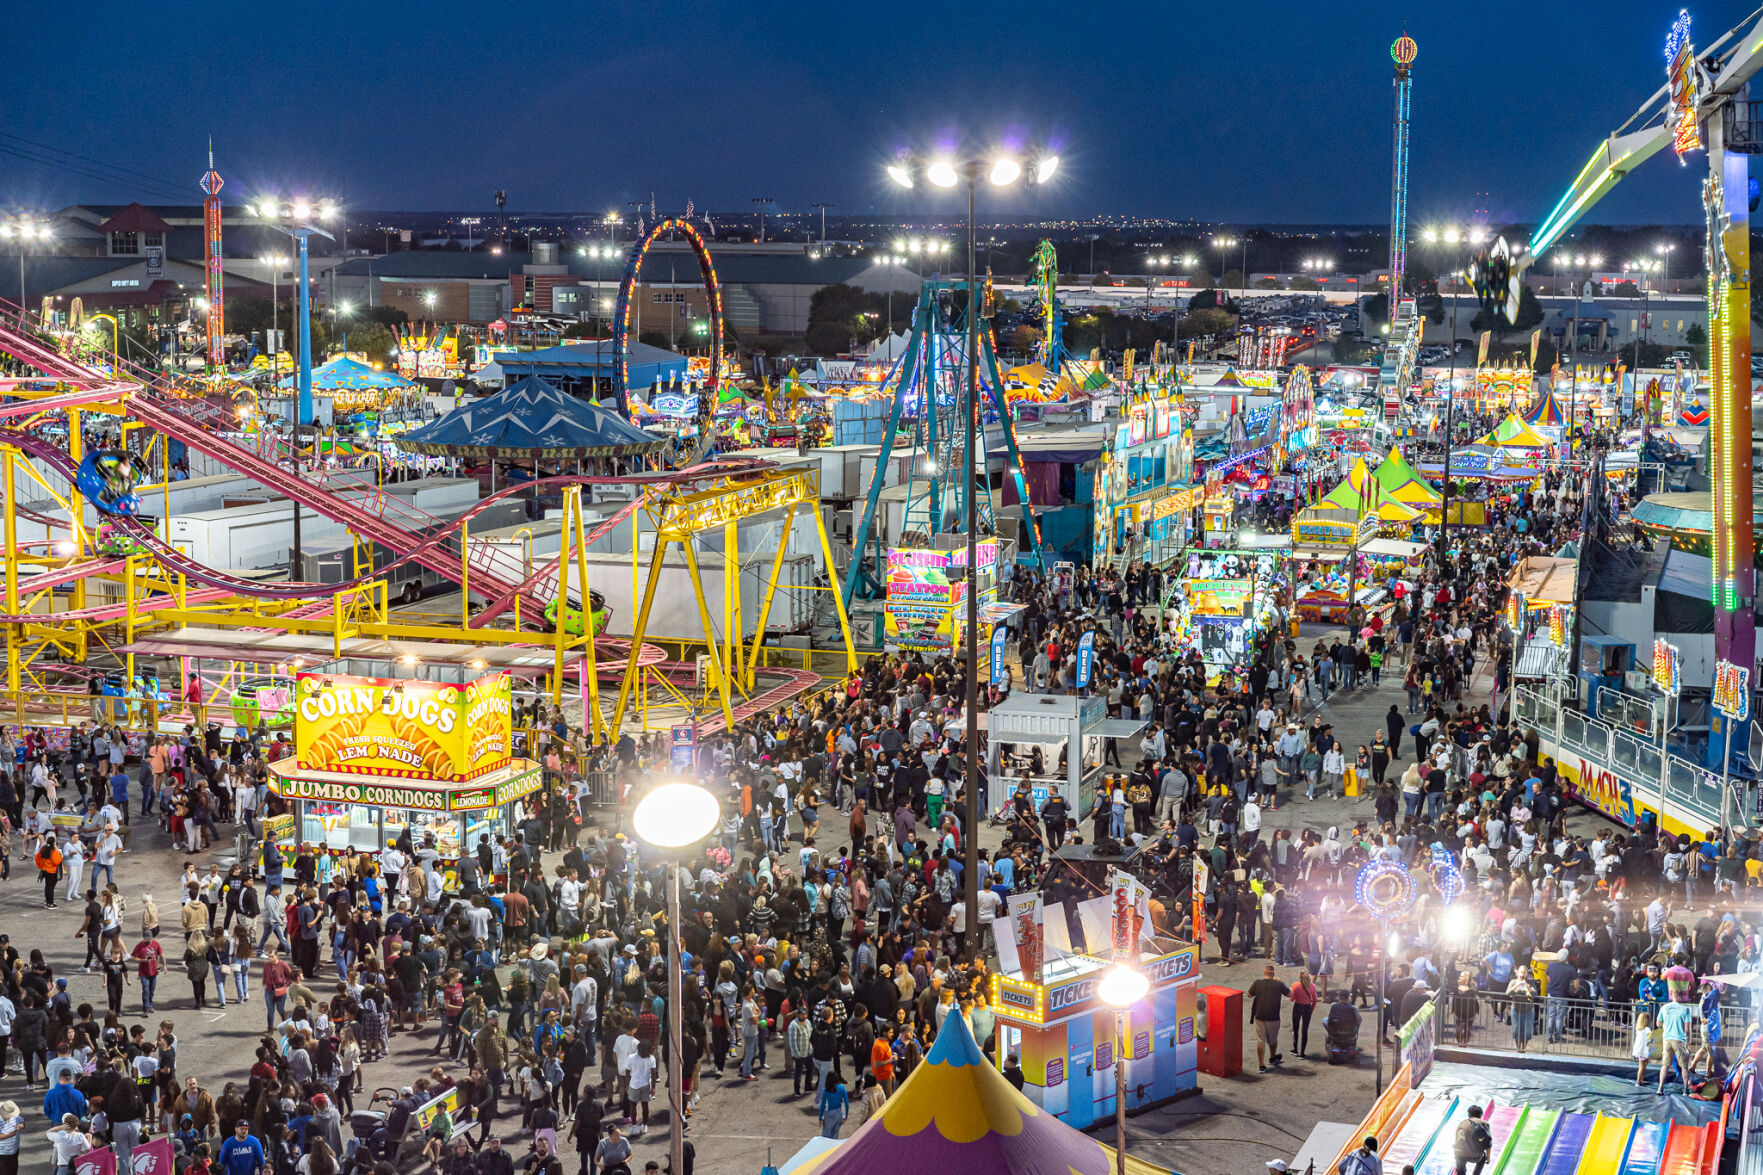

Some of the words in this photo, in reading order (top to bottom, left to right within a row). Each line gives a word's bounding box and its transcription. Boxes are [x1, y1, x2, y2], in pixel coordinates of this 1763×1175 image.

[890, 582, 949, 594] STATION
[301, 688, 374, 722] CORN
[382, 685, 457, 733] DOGS
[467, 699, 488, 728] CORN
[489, 696, 509, 716] DOGS
[344, 736, 370, 746] FRESH
[372, 735, 416, 751] SQUEEZED
[285, 780, 361, 801] JUMBO
[366, 787, 442, 809] CORNDOGS
[456, 795, 488, 808] LEMONADE
[498, 770, 541, 803] CORNDOGS
[1575, 758, 1620, 817] MACH
[1618, 778, 1636, 828] 3
[1016, 900, 1035, 913] BUY
[1003, 991, 1033, 1006] TICKETS
